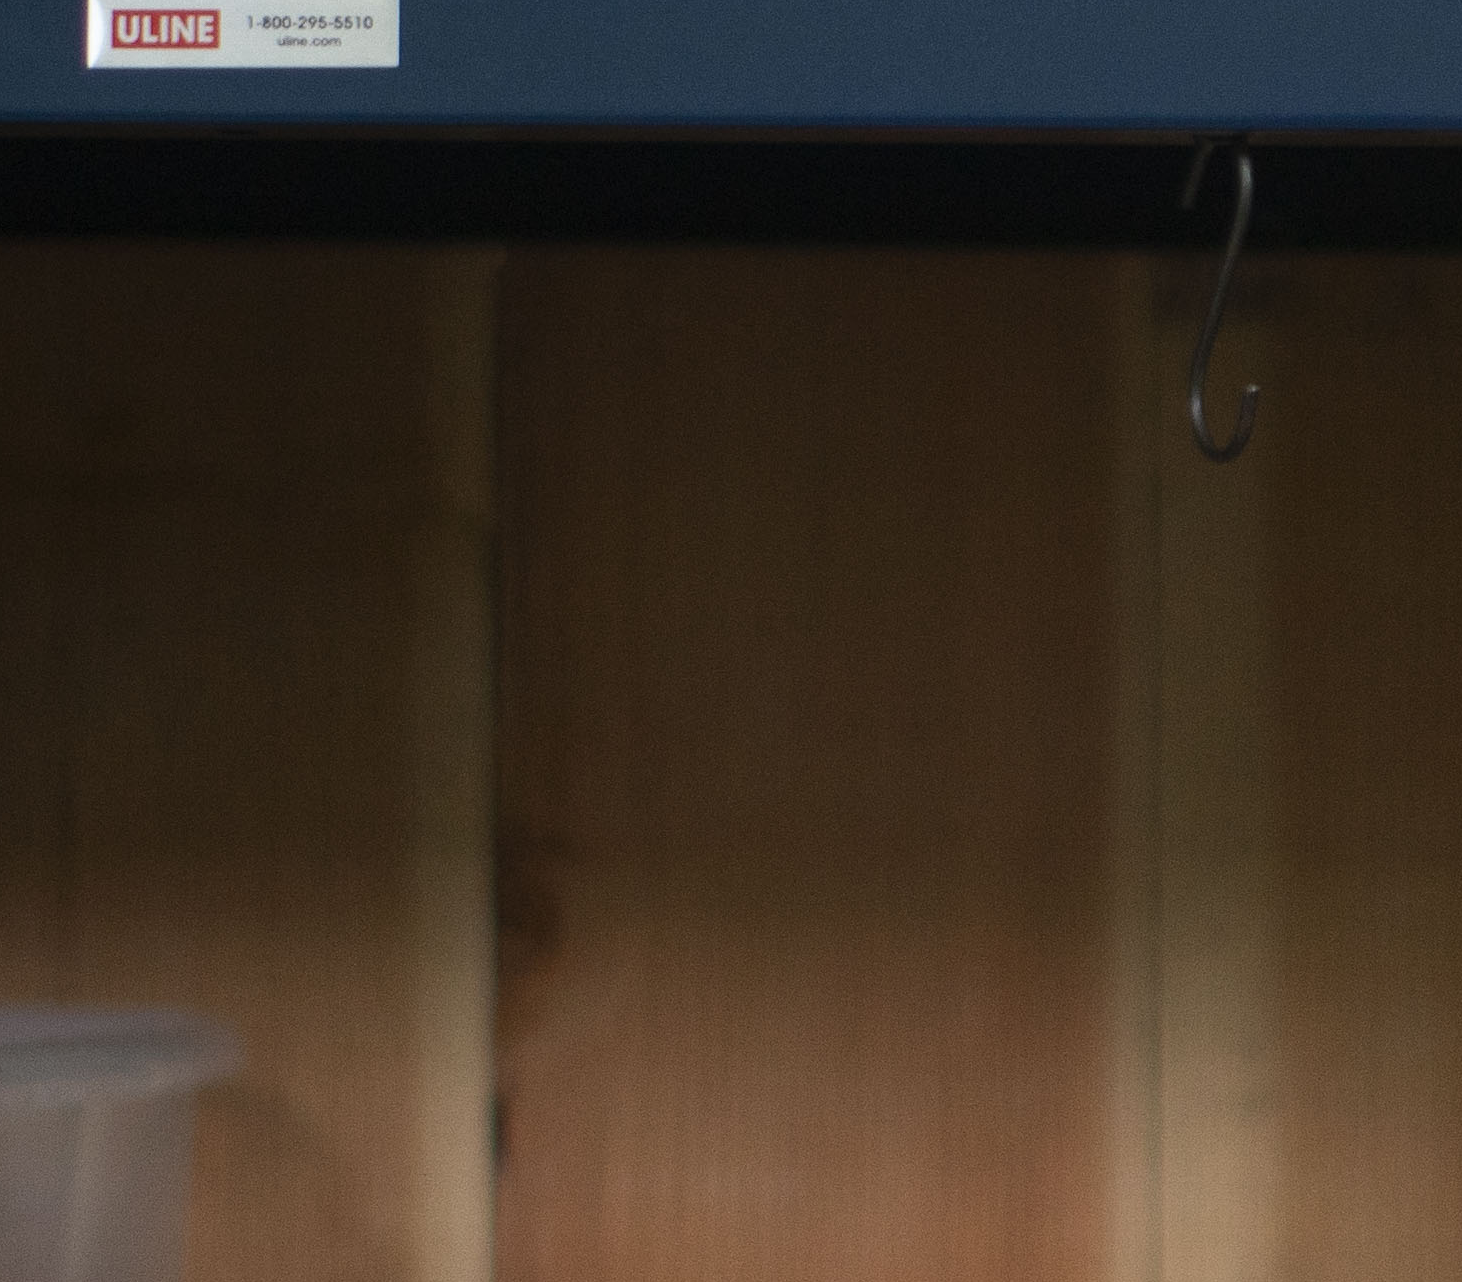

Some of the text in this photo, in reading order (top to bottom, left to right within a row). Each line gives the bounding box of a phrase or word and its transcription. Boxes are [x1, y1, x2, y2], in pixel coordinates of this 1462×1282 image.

[116, 14, 215, 45] ULINE
[246, 15, 374, 30] 1-800-295-5510
[276, 35, 342, 48] uline.com
